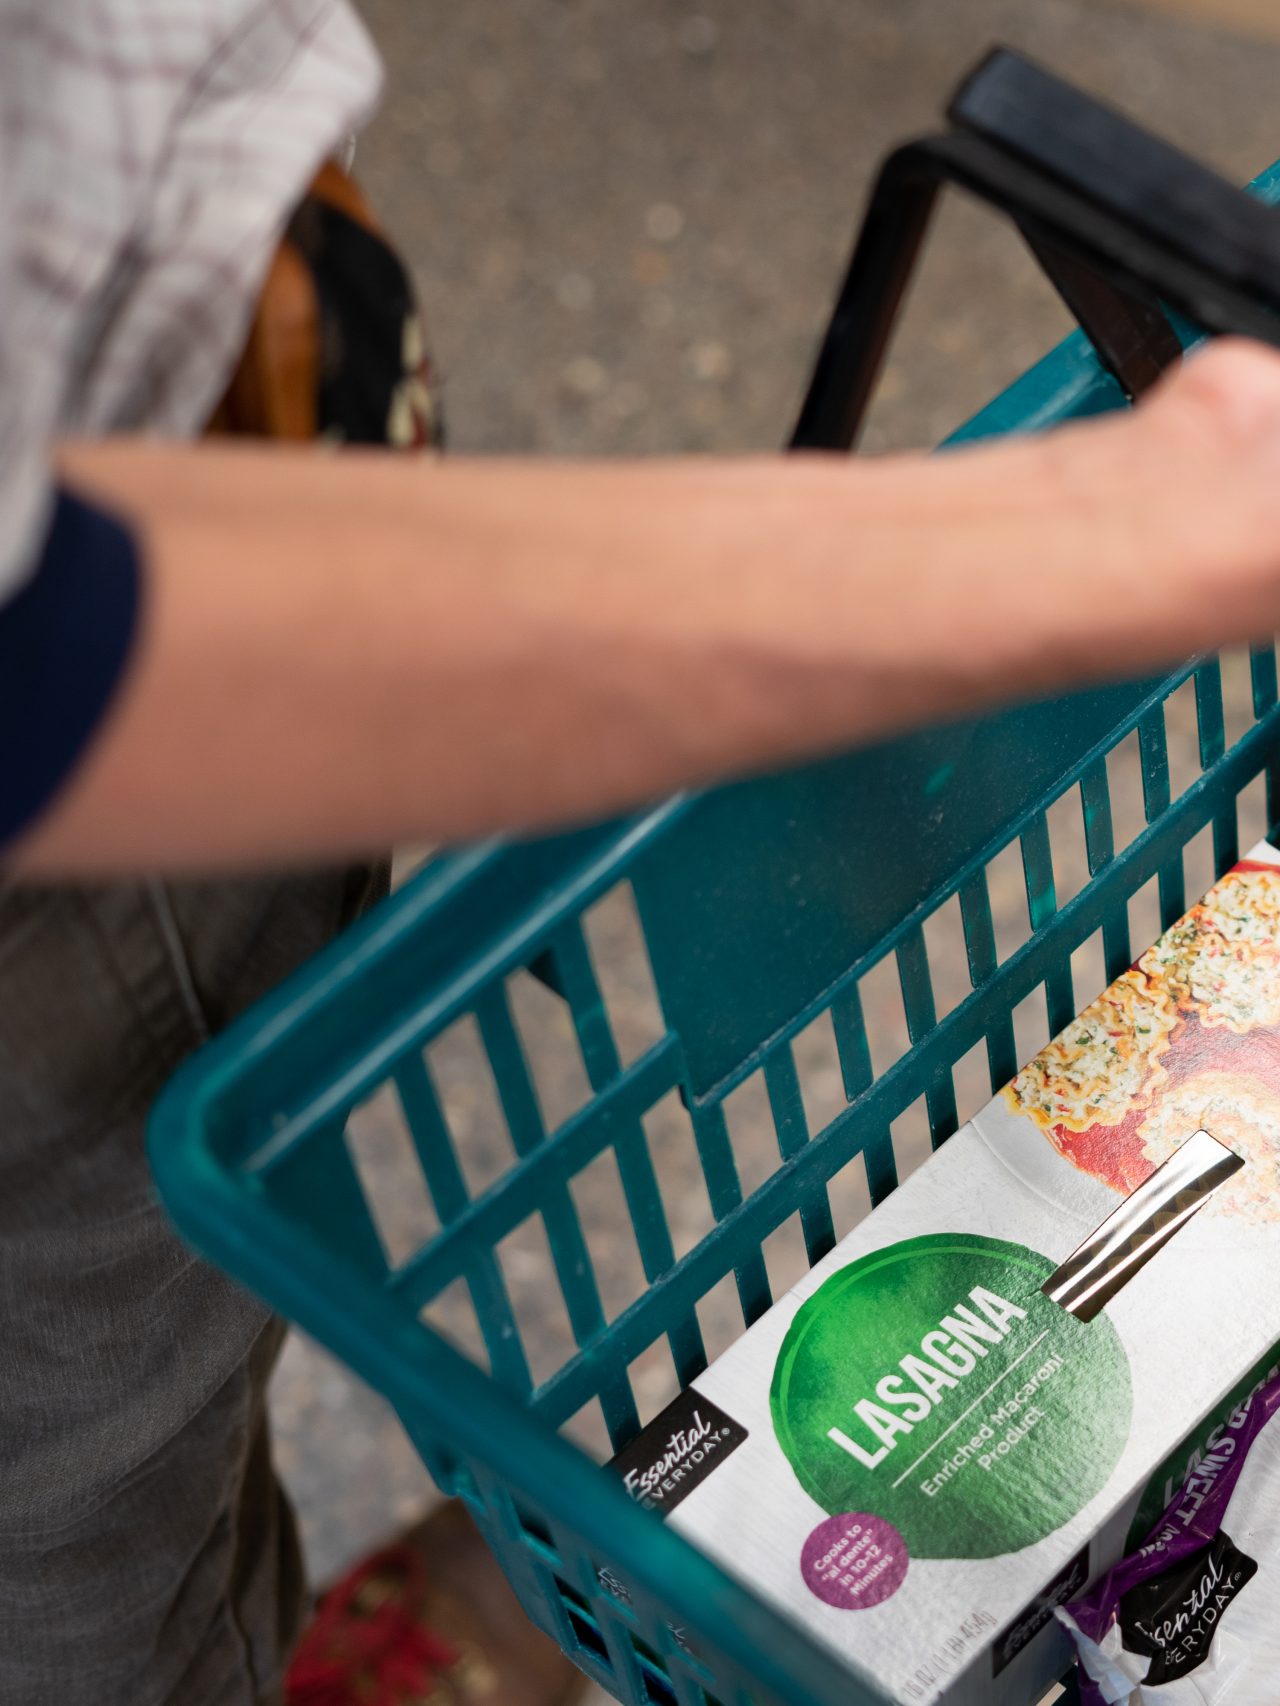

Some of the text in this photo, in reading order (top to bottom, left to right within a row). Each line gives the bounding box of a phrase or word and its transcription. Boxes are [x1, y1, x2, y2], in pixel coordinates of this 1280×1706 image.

[827, 1286, 1028, 1470] LASAGNA
[623, 1410, 711, 1502] Essential
[921, 1351, 1064, 1497] Enriched Macaroni
[977, 1406, 1045, 1471] Product
[814, 1525, 862, 1570] Cooks to
[850, 1544, 881, 1573] 10-12
[850, 1554, 893, 1595] Minutes
[1165, 1575, 1235, 1665] ERYDAY
